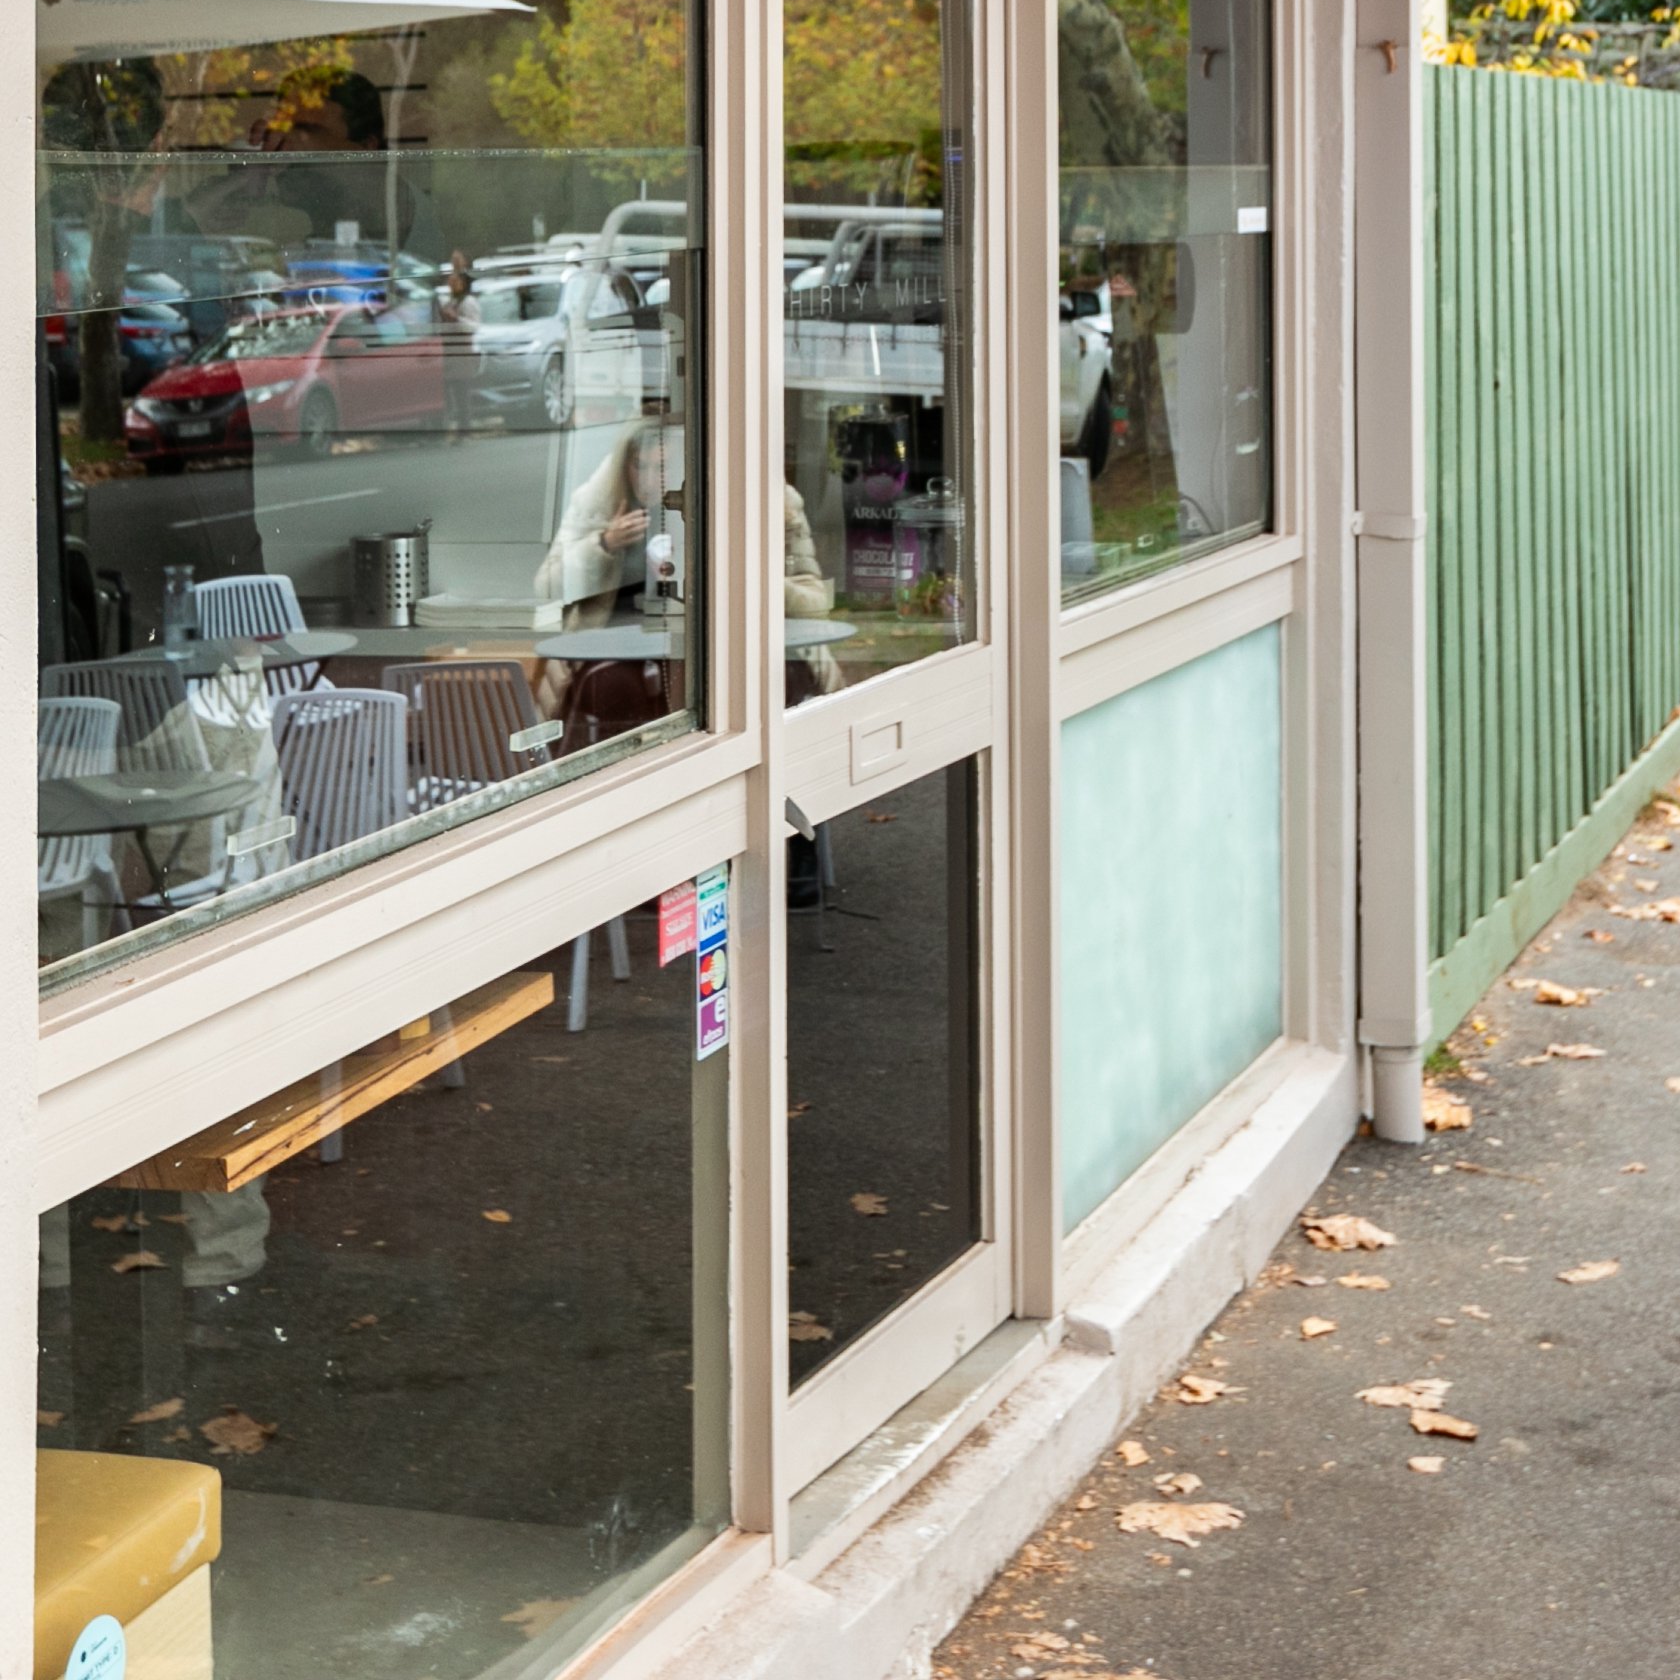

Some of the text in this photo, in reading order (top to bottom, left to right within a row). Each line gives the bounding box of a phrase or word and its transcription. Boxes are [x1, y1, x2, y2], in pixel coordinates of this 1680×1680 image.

[789, 275, 948, 318] HIRTY MILL
[852, 506, 898, 520] ARKAD
[702, 901, 725, 932] VISA
